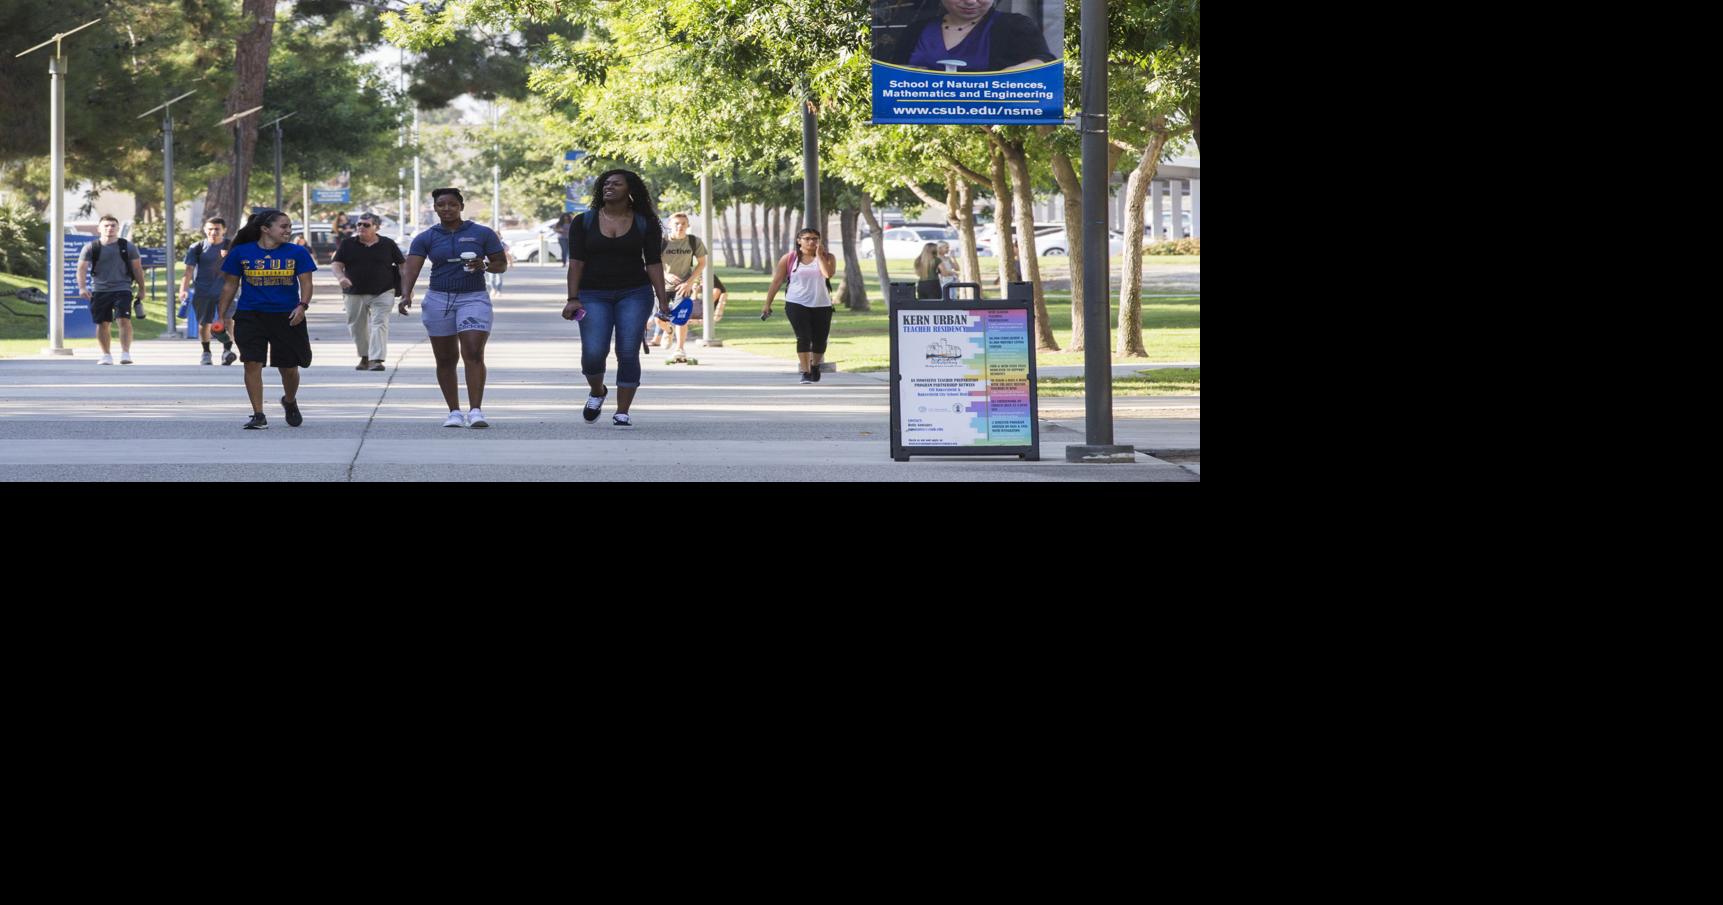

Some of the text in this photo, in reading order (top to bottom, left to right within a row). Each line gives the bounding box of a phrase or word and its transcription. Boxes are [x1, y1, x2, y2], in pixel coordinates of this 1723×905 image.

[889, 79, 1047, 90] School of Natural Sciences,
[882, 89, 1054, 100] Mathematics and Engineering
[893, 105, 1043, 116] www.csub.edu/nsme
[903, 314, 968, 325] KERN URBAN
